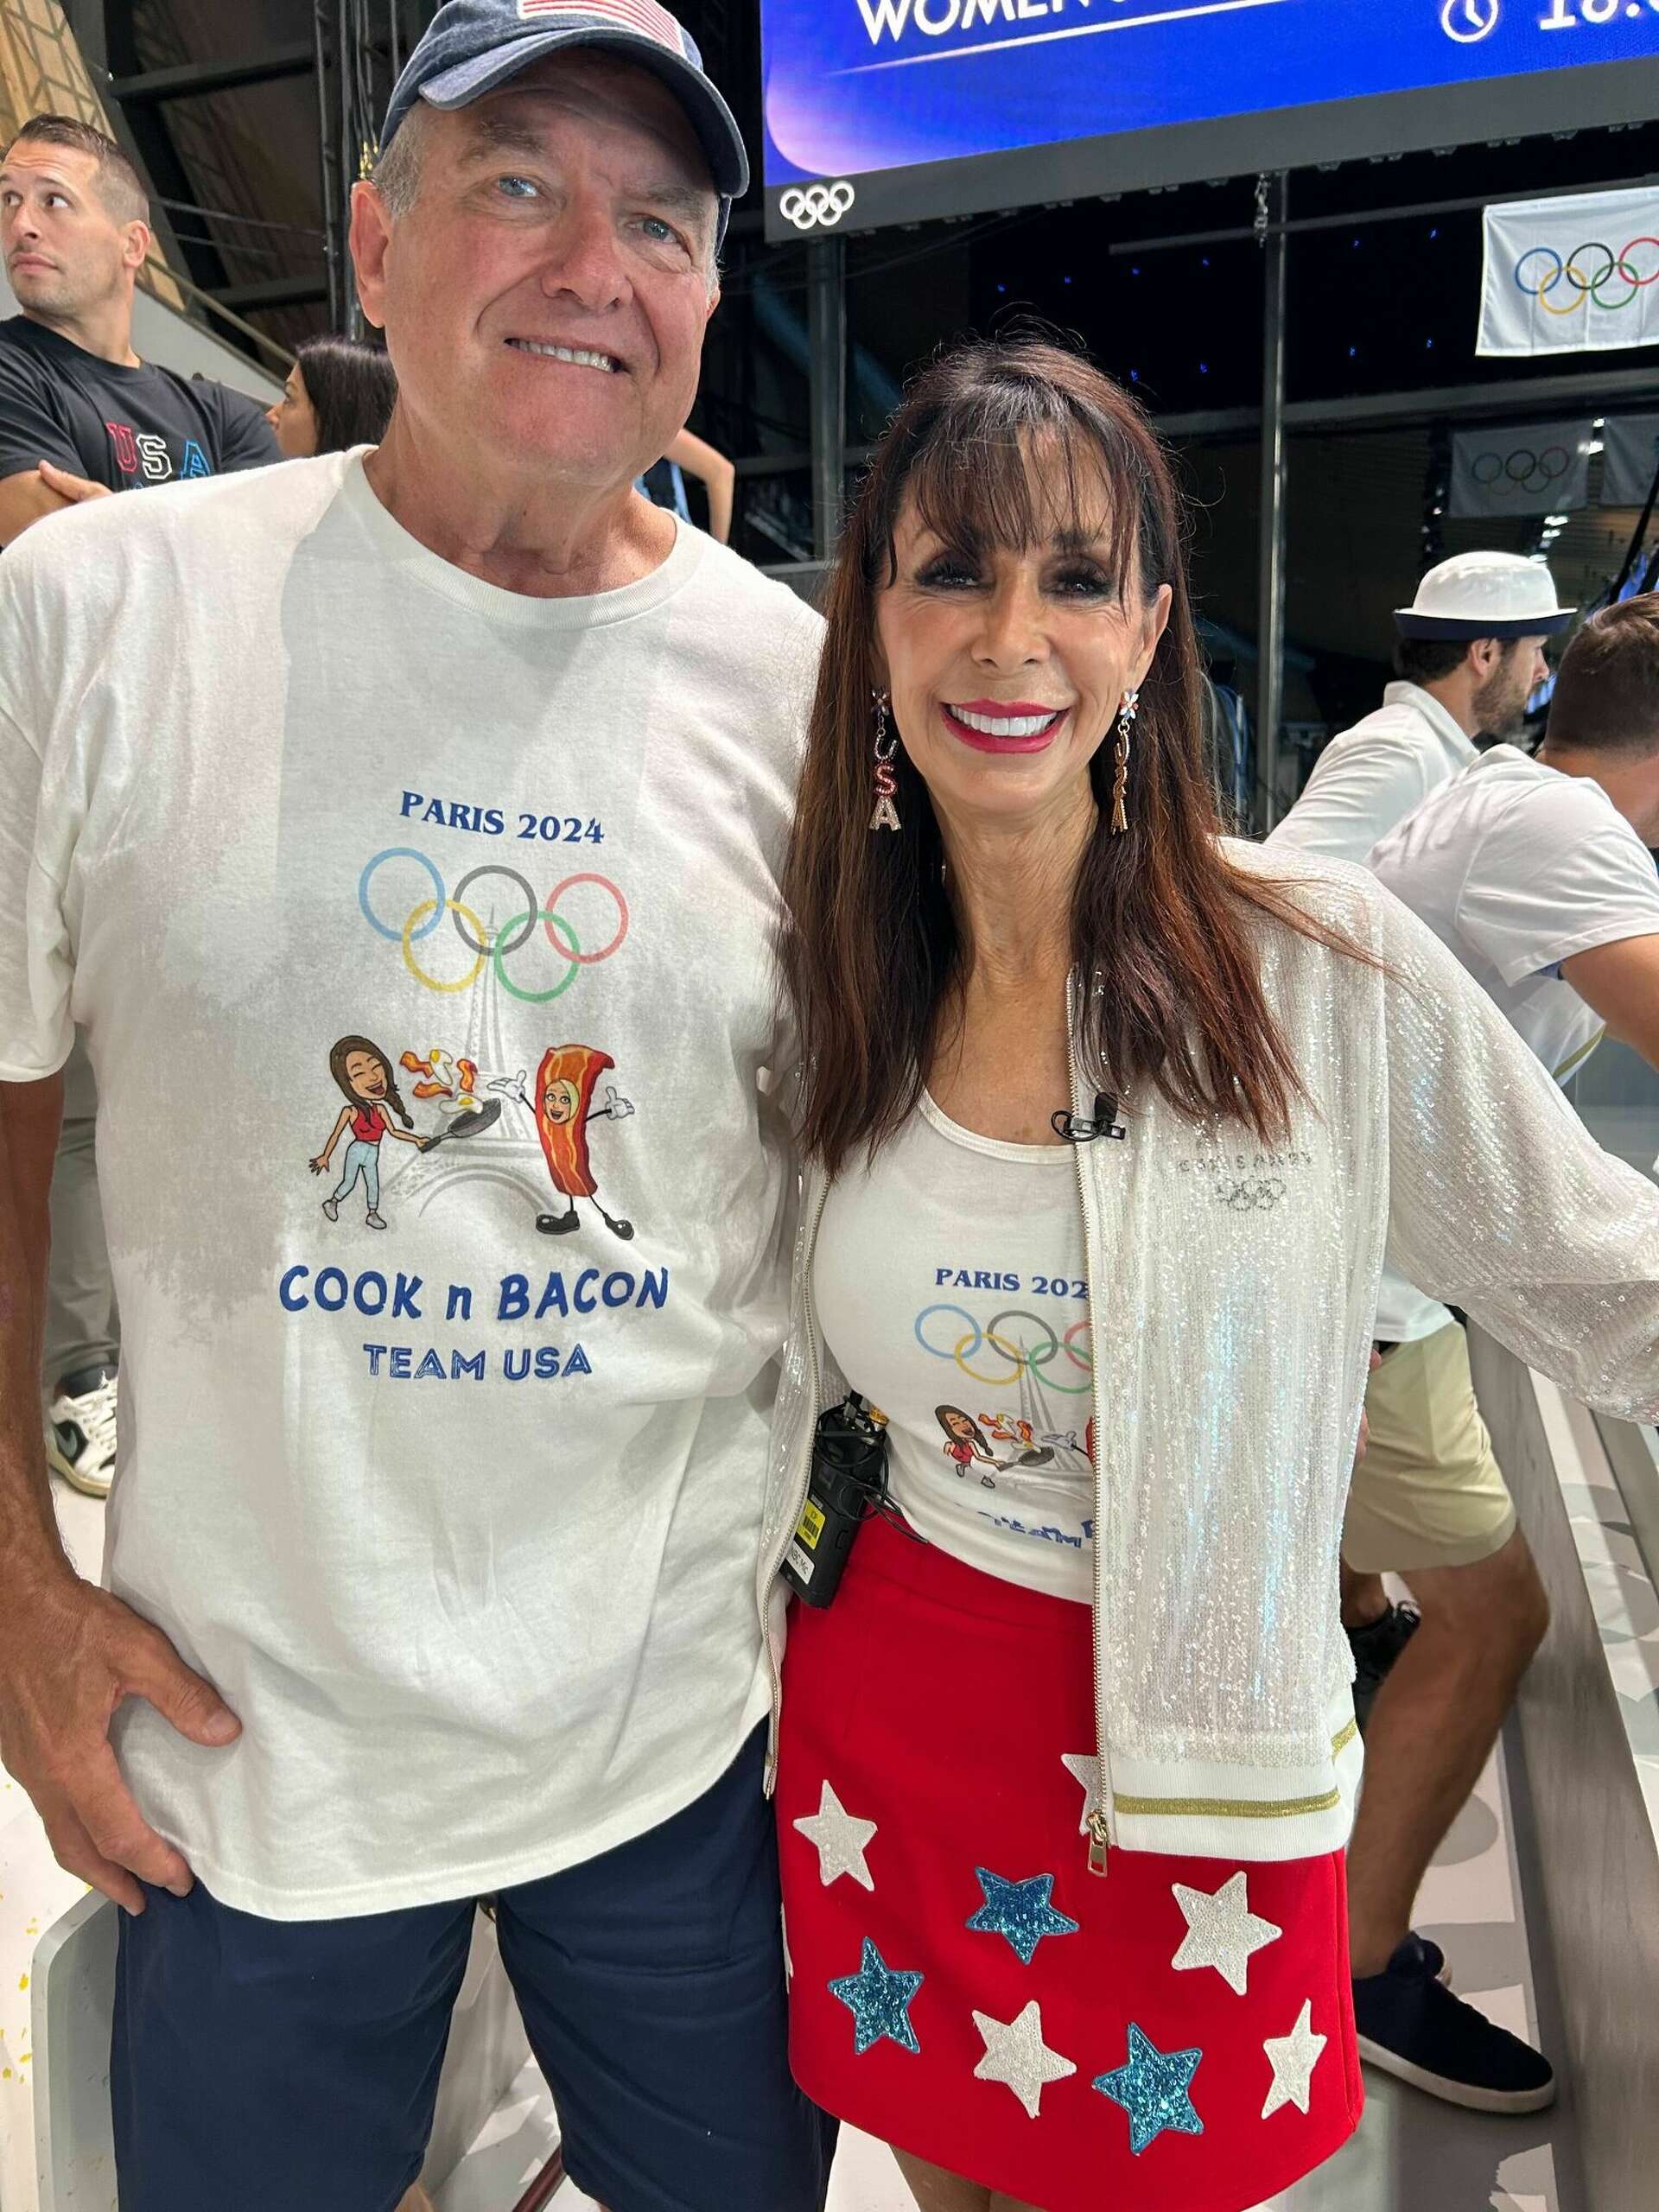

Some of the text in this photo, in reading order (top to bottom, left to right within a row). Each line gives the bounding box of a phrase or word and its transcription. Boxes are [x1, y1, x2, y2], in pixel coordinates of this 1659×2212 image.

[105, 422, 210, 480] USA
[399, 790, 605, 844] PARIS 2024
[278, 1264, 669, 1321] COOK n BACON
[935, 1268, 1021, 1292] PARIS
[362, 1343, 593, 1381] TEAM USA
